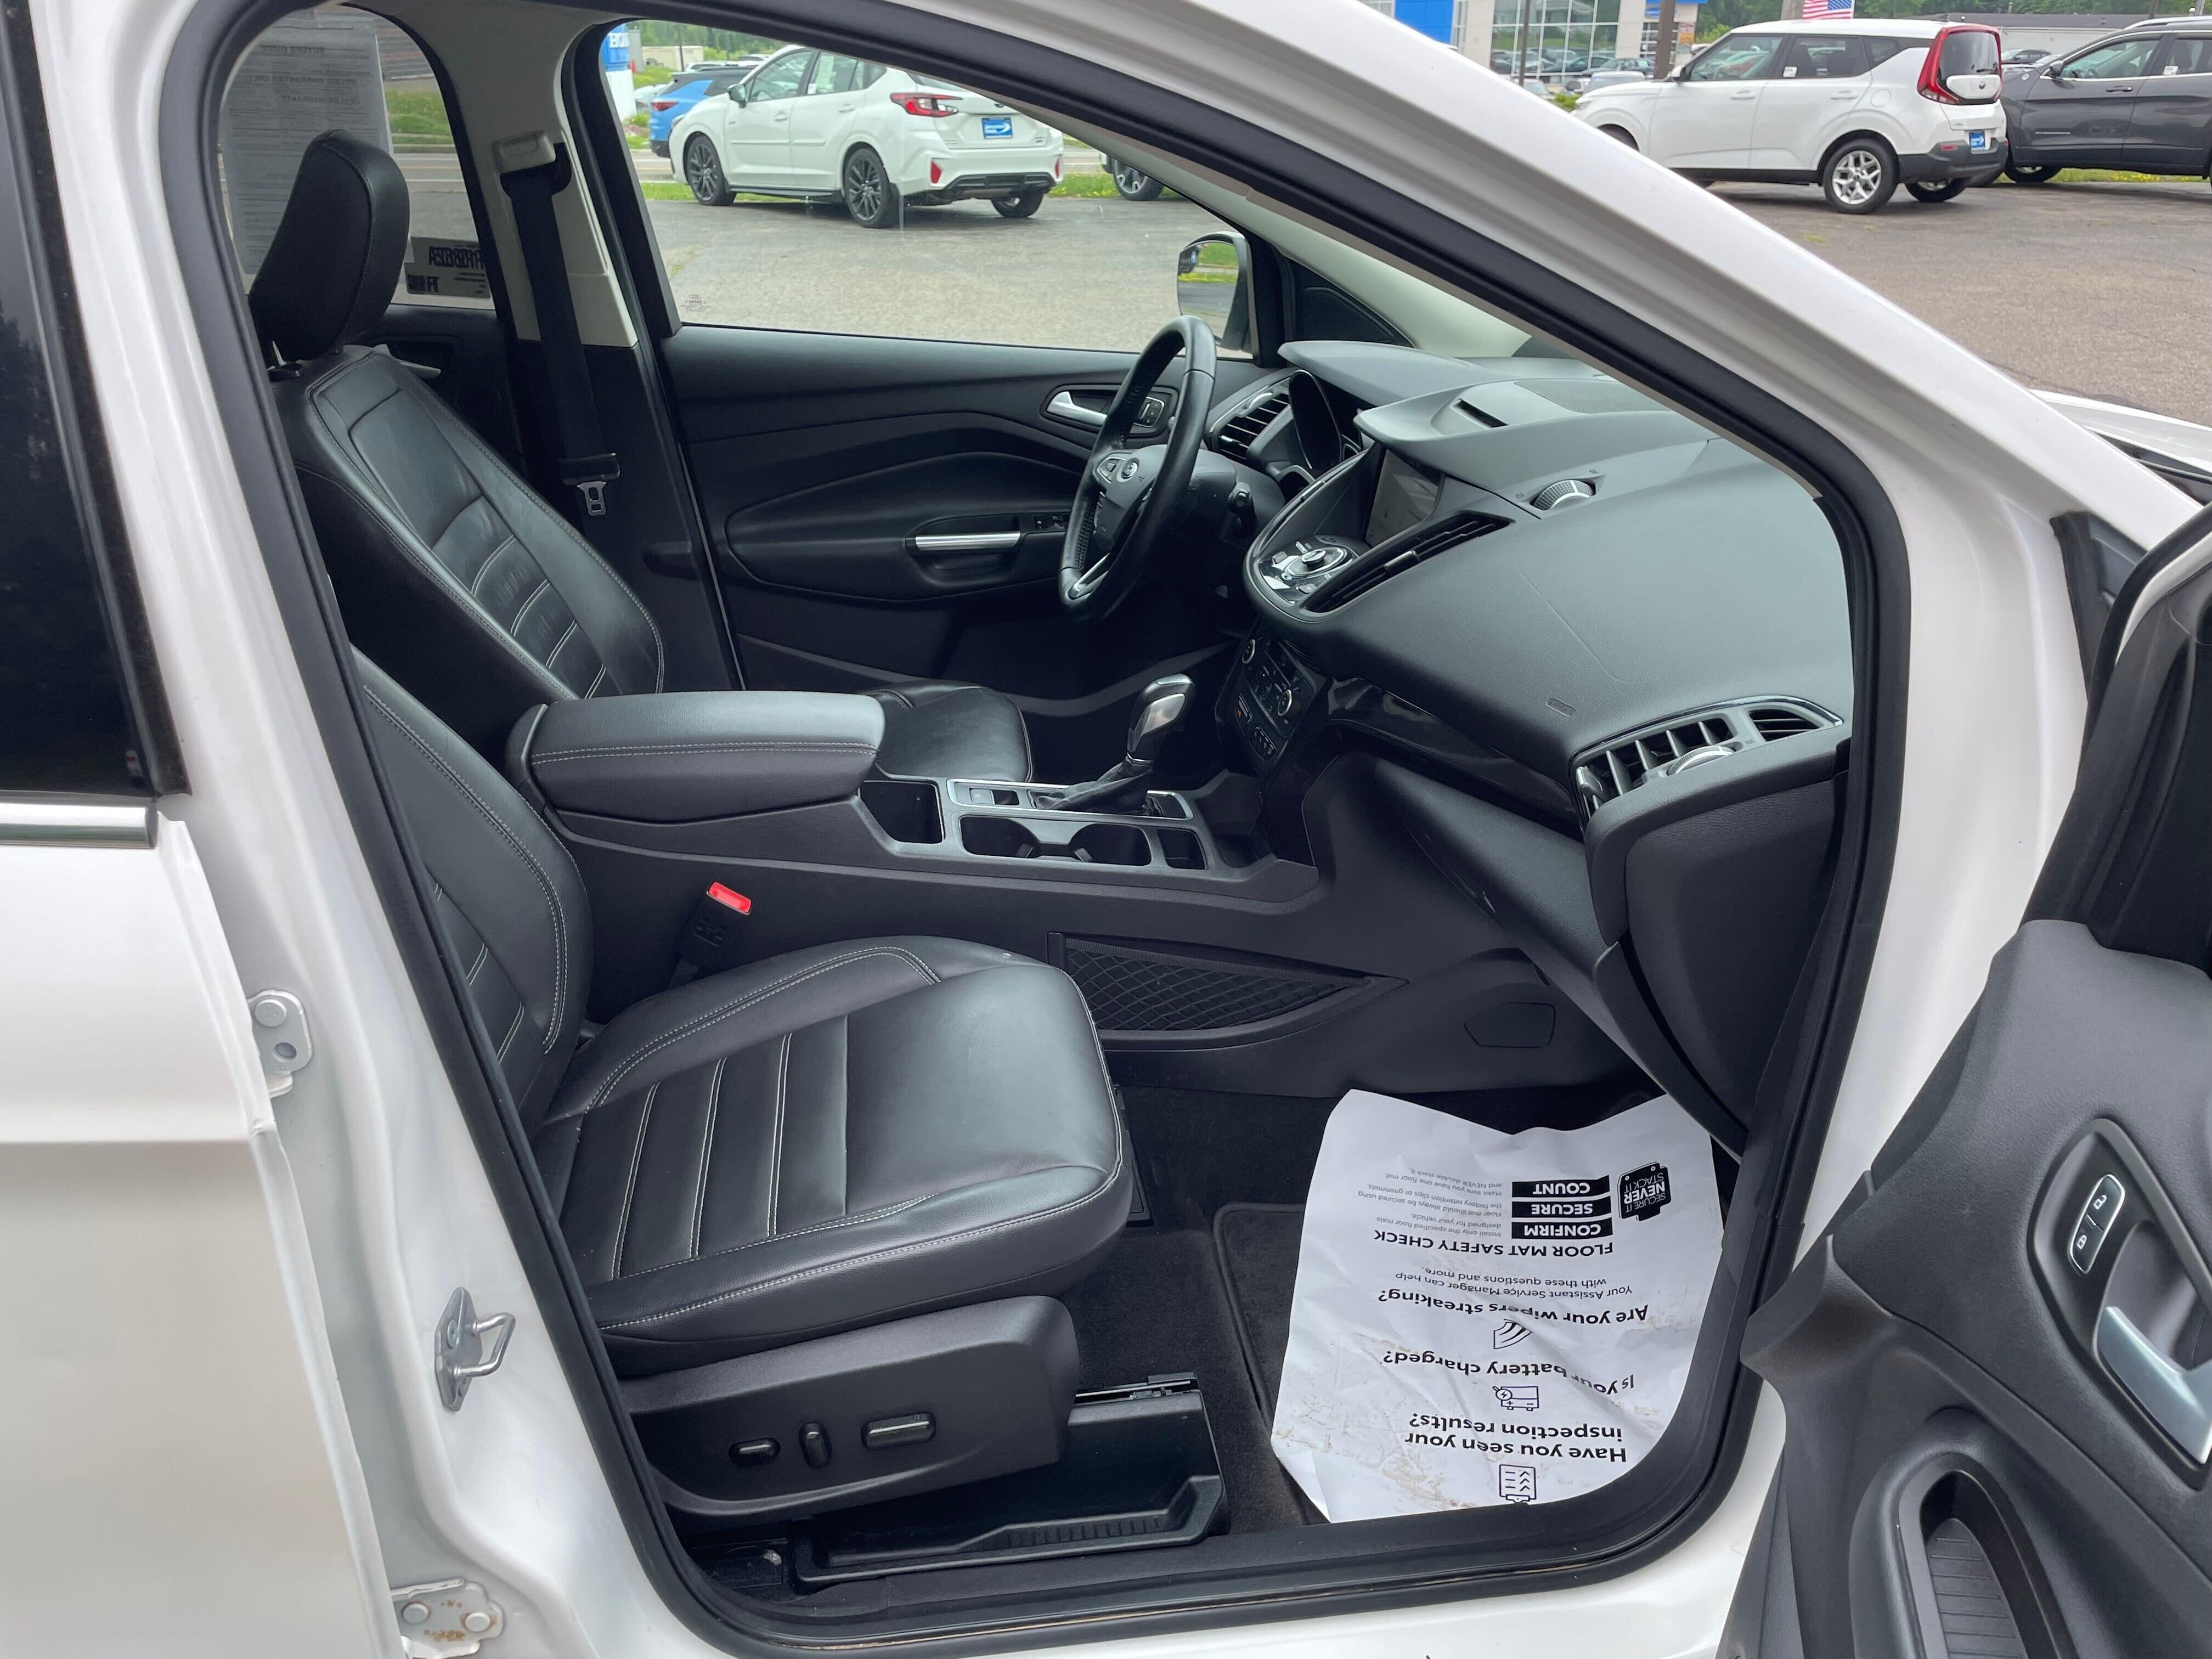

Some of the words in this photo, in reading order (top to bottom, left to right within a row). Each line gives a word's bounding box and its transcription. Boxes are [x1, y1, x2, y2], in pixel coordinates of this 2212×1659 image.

[1401, 1175, 1417, 1183] floor
[1436, 1174, 1461, 1184] double
[1633, 1172, 1664, 1190] STACK
[1533, 1182, 1590, 1195] COUNT
[1624, 1183, 1632, 1193] IT
[1624, 1181, 1665, 1204] NEVER
[1358, 1190, 1376, 1199] using
[1379, 1195, 1406, 1204] secured
[1414, 1191, 1429, 1200] clips
[1431, 1195, 1463, 1205] retention
[1418, 1201, 1441, 1211] always
[1464, 1200, 1488, 1209] factory
[1633, 1193, 1666, 1210] SECURE
[1443, 1206, 1466, 1215] should
[1531, 1203, 1593, 1215] SECURE
[1625, 1204, 1632, 1212] IT
[1414, 1223, 1447, 1232] specified
[1468, 1221, 1501, 1229] designed
[1524, 1223, 1601, 1237] CONFIRM
[1373, 1229, 1434, 1248] CHECK
[1437, 1240, 1504, 1255] SAFETY
[1508, 1245, 1547, 1257] MAT
[1552, 1242, 1613, 1257] FLOOR
[1396, 1272, 1421, 1282] help
[1421, 1266, 1455, 1278] more.
[1458, 1272, 1480, 1284] and
[1425, 1276, 1444, 1288] can
[1484, 1275, 1542, 1287] questions
[1544, 1278, 1577, 1288] these
[1582, 1278, 1606, 1289] with
[1447, 1280, 1500, 1295] Manager
[1503, 1288, 1546, 1298] Service
[1606, 1285, 1633, 1298] Your
[1378, 1288, 1483, 1314] streaking?
[1549, 1290, 1604, 1300] Assistant
[1489, 1303, 1558, 1321] wipers
[1563, 1311, 1611, 1324] your
[1615, 1304, 1649, 1324] Are
[1383, 1351, 1481, 1376] charged?
[1486, 1362, 1567, 1378] battery
[1571, 1374, 1618, 1395] your
[1622, 1374, 1634, 1389] Is
[1409, 1413, 1494, 1434] results?
[1502, 1423, 1622, 1442] inspection
[1405, 1433, 1456, 1449] your
[1462, 1439, 1514, 1454] seen
[1521, 1444, 1562, 1458] you
[1568, 1447, 1626, 1463] Have
